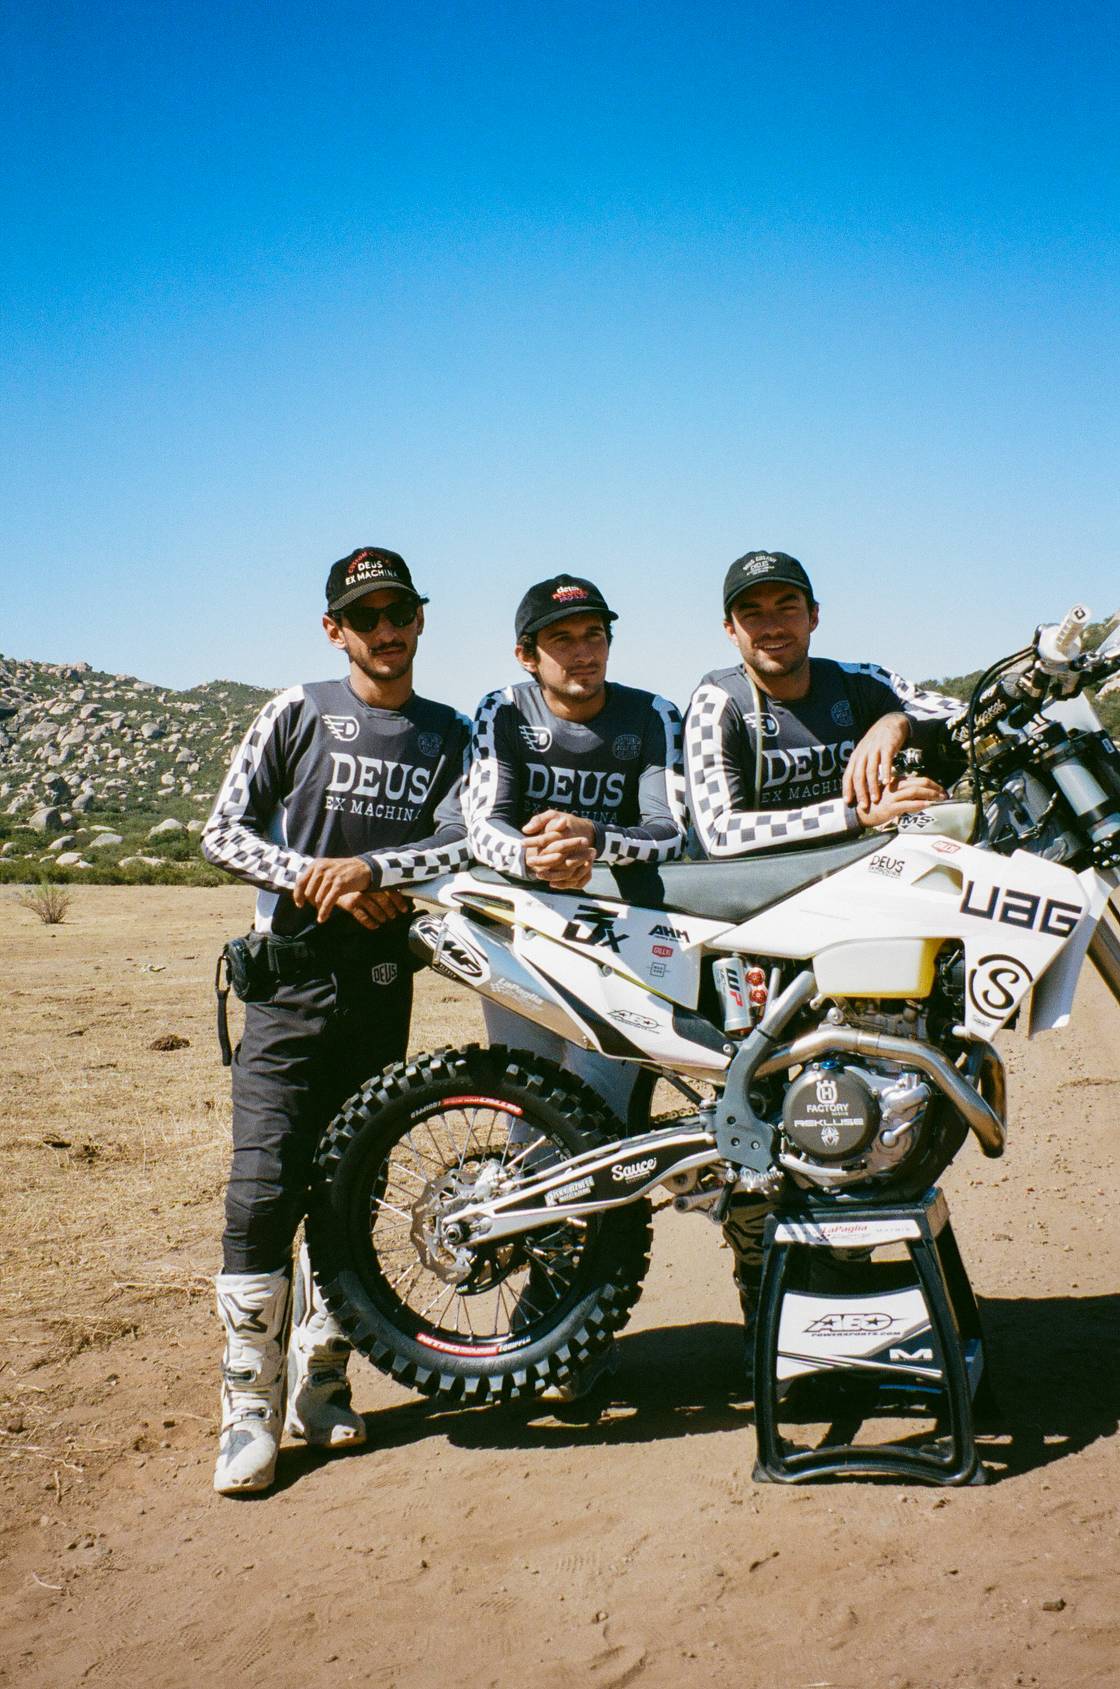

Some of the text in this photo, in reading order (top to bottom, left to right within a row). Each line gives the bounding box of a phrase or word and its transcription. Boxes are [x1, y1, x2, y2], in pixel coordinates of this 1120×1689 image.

[358, 560, 383, 571] DEUS
[345, 576, 356, 585] EX
[761, 740, 855, 788] DEUS
[326, 752, 431, 804] DEUS
[525, 763, 626, 807] DEUS
[325, 796, 344, 811] EX
[761, 790, 782, 803] EX
[869, 855, 905, 873] DEUS
[648, 924, 690, 943] AHM
[373, 964, 397, 983] DEUS
[806, 1103, 849, 1113] FACTORY
[611, 1157, 658, 1181] Sauce
